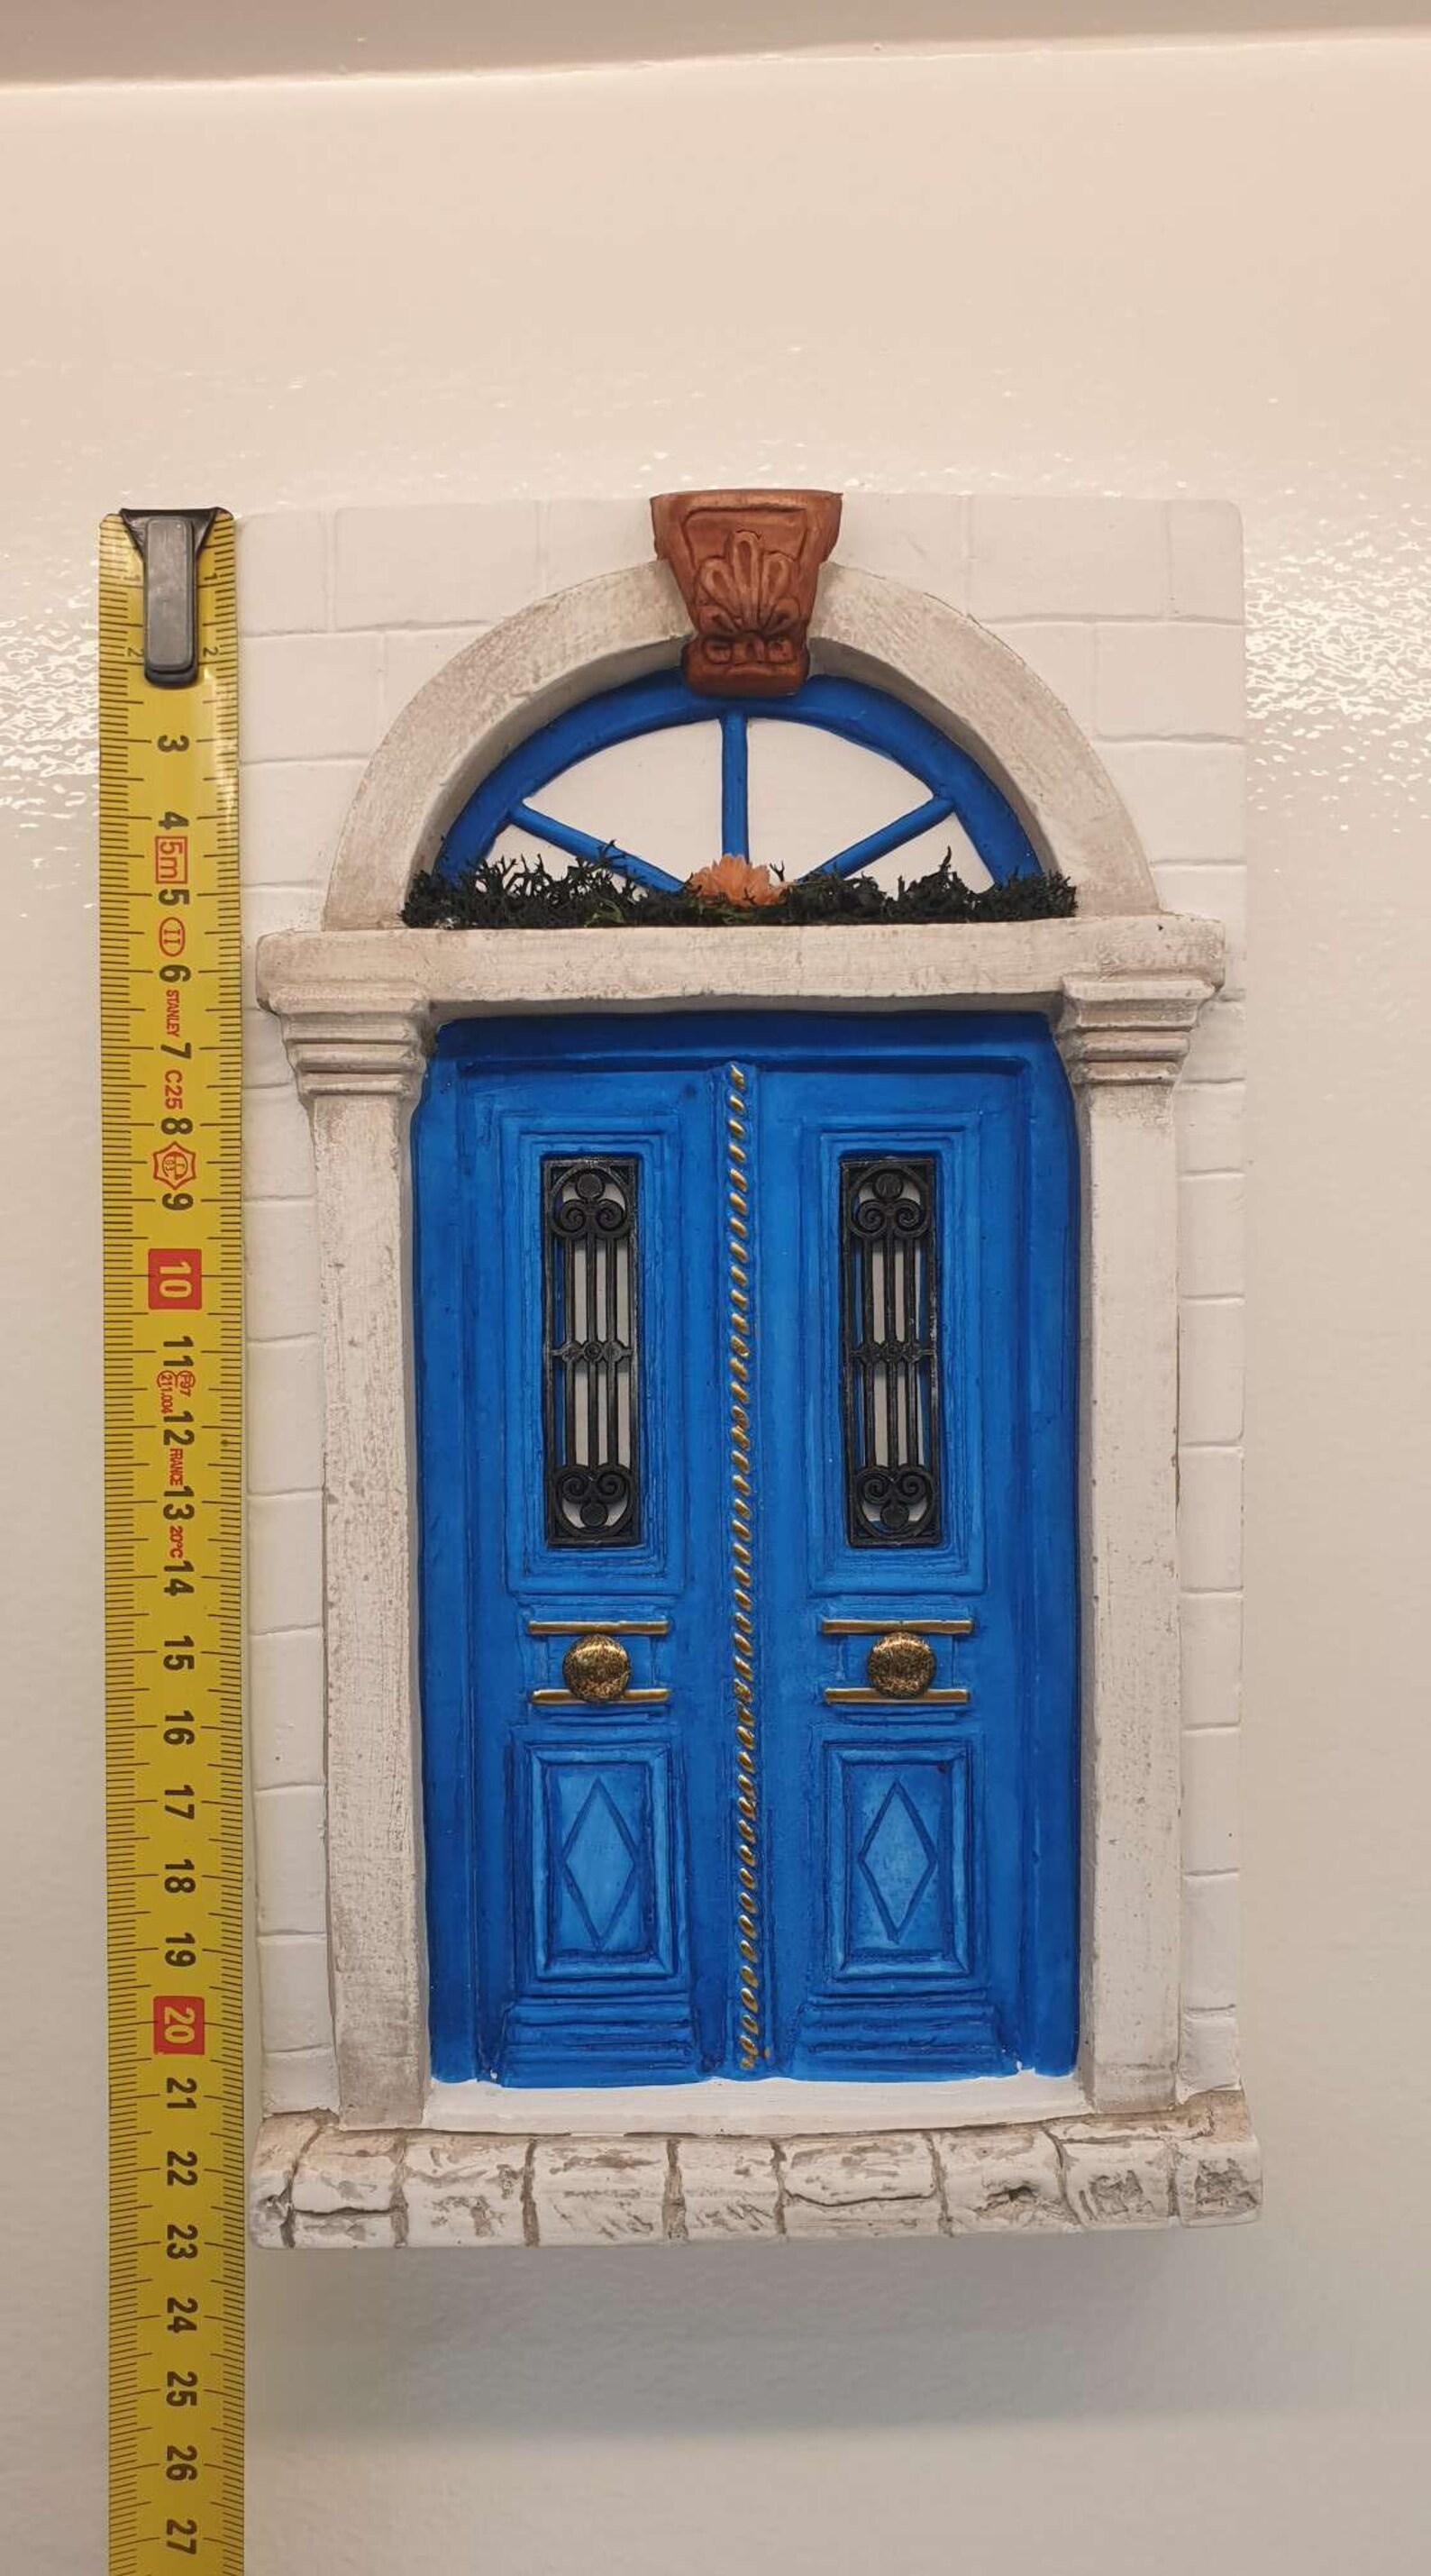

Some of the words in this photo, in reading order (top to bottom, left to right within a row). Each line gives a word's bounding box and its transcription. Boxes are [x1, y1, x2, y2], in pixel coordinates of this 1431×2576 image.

[204, 647, 219, 657] 2
[158, 735, 189, 753] 3
[159, 811, 189, 830] 4
[160, 840, 183, 879] 5m
[159, 889, 189, 906] 5
[160, 964, 191, 982] 6
[166, 990, 180, 1037] STANLEY
[160, 1042, 192, 1060] 7
[160, 1118, 193, 1135] 8
[161, 1193, 194, 1210] 9
[160, 1261, 192, 1298] 10
[163, 1336, 194, 1366] 11
[163, 1411, 195, 1446] 12
[169, 1448, 184, 1486] FRANCE
[163, 1485, 195, 1521] 13
[163, 1560, 195, 1596] 14
[163, 1635, 195, 1671] 15
[163, 1710, 196, 1745] 16
[164, 1785, 195, 1820] 17
[164, 1859, 196, 1894] 18
[165, 1932, 196, 1968] 19
[164, 2006, 196, 2044] 20
[166, 2077, 197, 2109] 21
[167, 2151, 198, 2187] 22
[167, 2224, 198, 2260] 23
[167, 2297, 198, 2334] 24
[166, 2371, 198, 2407] 25
[166, 2444, 198, 2481] 26
[166, 2519, 197, 2555] 27
